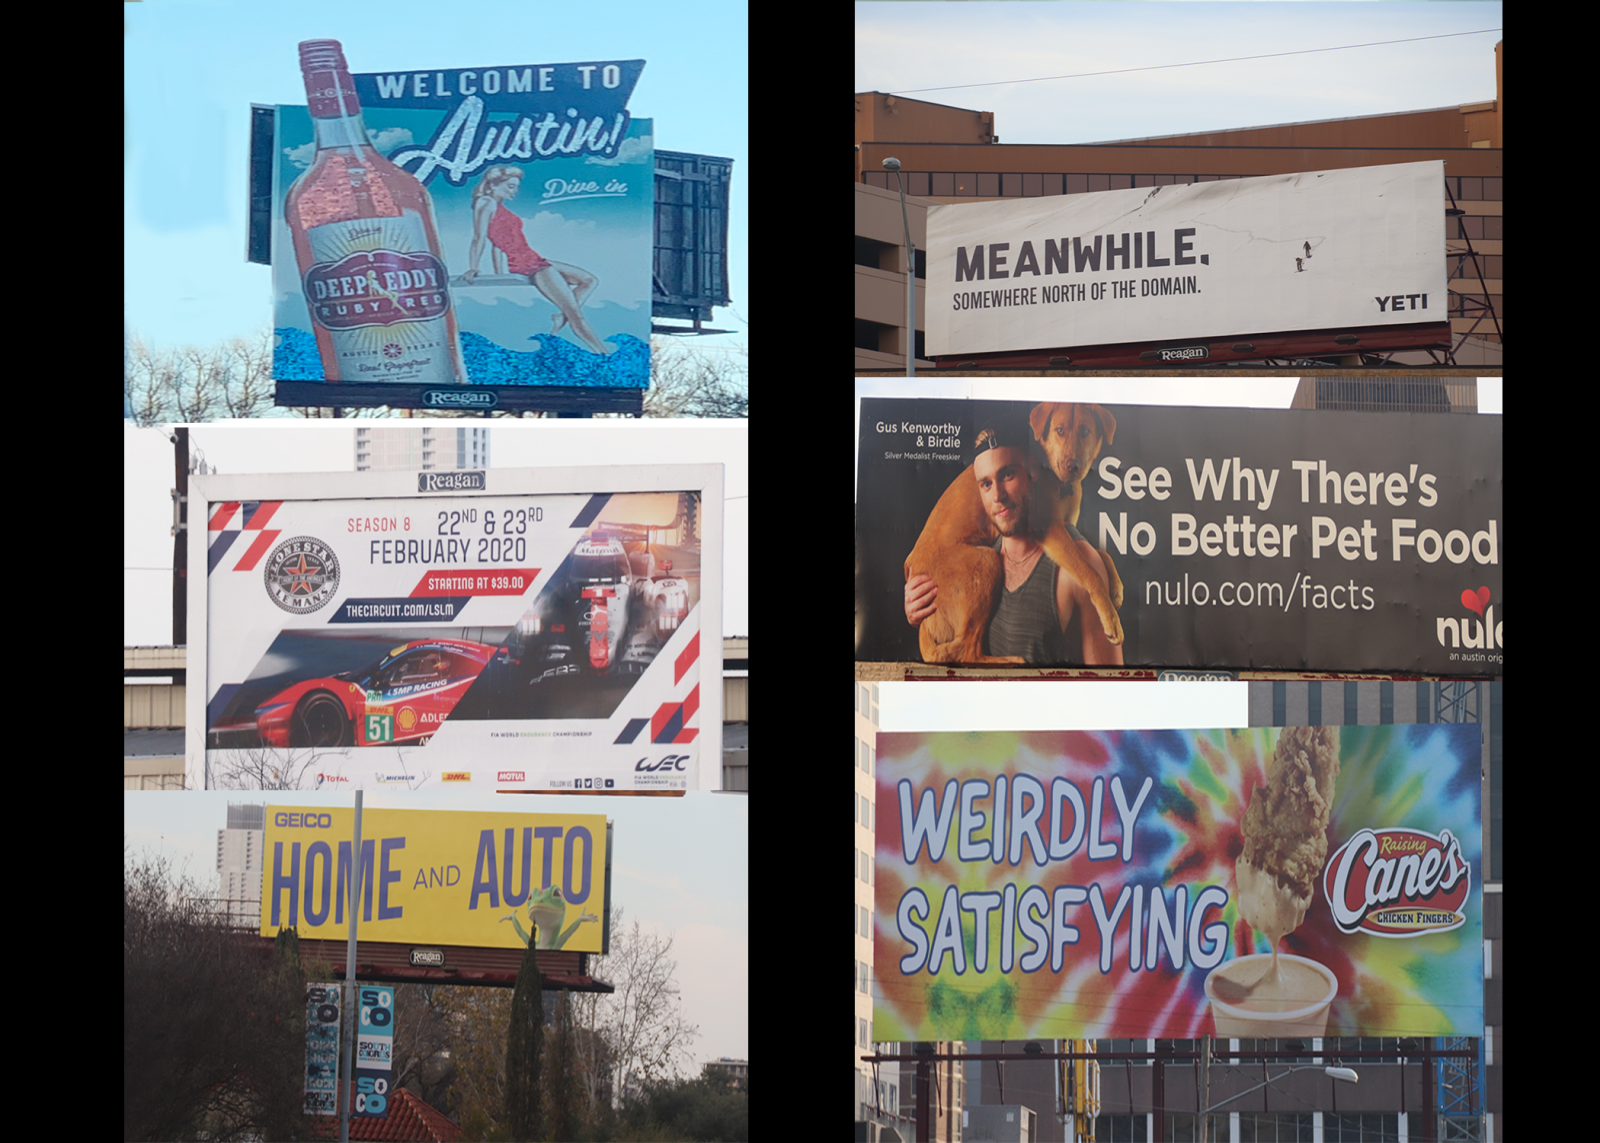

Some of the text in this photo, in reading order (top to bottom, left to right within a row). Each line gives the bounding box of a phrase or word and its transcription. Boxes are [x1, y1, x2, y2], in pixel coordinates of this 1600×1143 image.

[377, 64, 620, 98] WELCOME TO
[392, 95, 625, 184] Austin!
[543, 178, 628, 198] Dive in
[314, 268, 438, 299] DEEP EDDY
[953, 275, 1202, 311] SOMEWHERE NORTH OF THE DOMAIN.
[320, 302, 380, 316] RUBY
[405, 294, 442, 308] RED
[1375, 293, 1429, 313] YETI
[1161, 348, 1204, 360] Reagan
[429, 391, 491, 405] Reagan
[875, 421, 961, 437] Gus Kenworthy
[916, 435, 961, 448] & Birdie
[884, 451, 961, 461] Silver Medalist Freeskier
[426, 472, 480, 491] Reagan
[1098, 456, 1439, 511] See Why There's
[347, 516, 411, 532] SEASON 8
[438, 507, 543, 536] 22ND & 23RD
[1099, 511, 1499, 565] No Better Pet Food
[270, 542, 334, 573] LONE STAR
[370, 537, 526, 565] FEBRUARY 2020
[428, 576, 524, 590] STARTING AT $39.00
[1145, 573, 1376, 612] nulo.com/facts
[275, 587, 329, 607] LE MANS
[346, 603, 454, 617] THECIRCUIT.COM/LSLM
[1449, 652, 1460, 661] an
[1461, 652, 1486, 662] austin
[393, 679, 448, 696] SMP RACING
[369, 716, 391, 740] 51
[634, 754, 690, 772] WEC
[326, 774, 349, 783] TOTAL
[499, 772, 525, 781] MOTUL
[274, 812, 332, 829] GEICO
[899, 773, 1154, 867] WEIRDLY
[1380, 836, 1427, 856] Raising
[270, 825, 593, 927] HOME AND AUTO
[1332, 830, 1467, 928] Cane's
[1377, 912, 1454, 924] CHICKEN FINGERS
[897, 883, 1230, 976] SATISFYING
[413, 951, 441, 963] Reagan
[361, 990, 392, 1008] SO
[359, 1041, 391, 1051] SOUTH
[357, 1077, 388, 1095] SO
